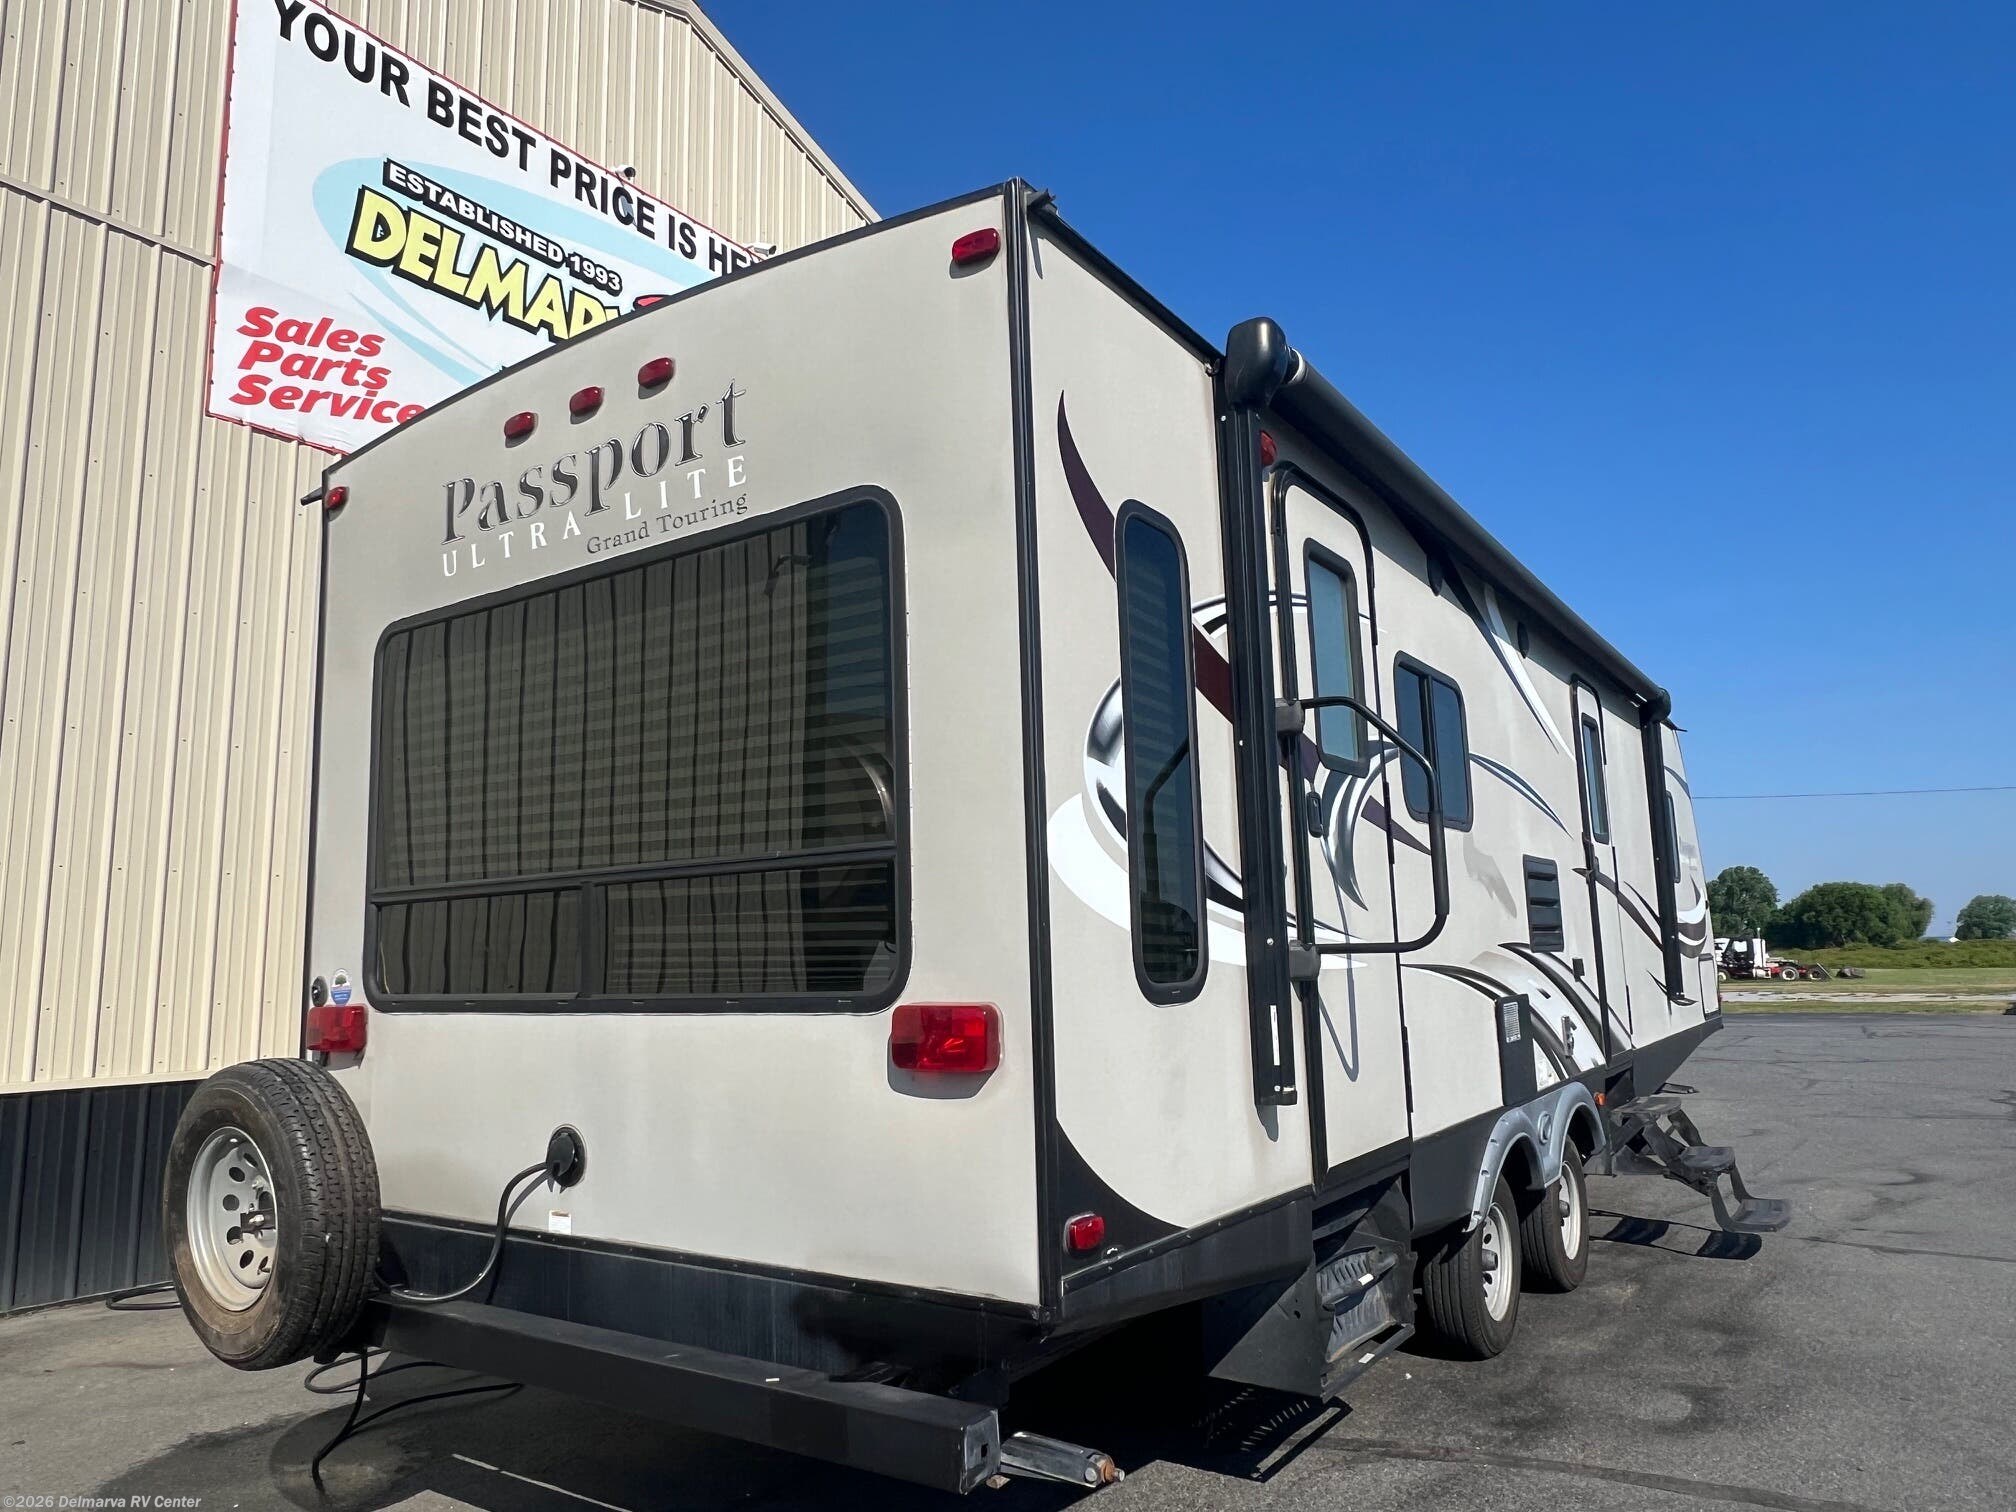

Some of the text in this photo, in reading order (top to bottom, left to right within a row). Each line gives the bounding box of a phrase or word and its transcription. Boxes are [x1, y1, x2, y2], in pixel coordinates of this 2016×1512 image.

[274, 0, 754, 276] YOUR BEST PRICE IS HE
[387, 160, 621, 292] ESTABLISHED 1993
[236, 306, 386, 357] Sales
[237, 340, 392, 390] Parts
[229, 374, 427, 424] Service
[442, 378, 747, 546] Passport
[442, 455, 747, 577] ULTRA LITE
[586, 493, 748, 554] Grand Touring
